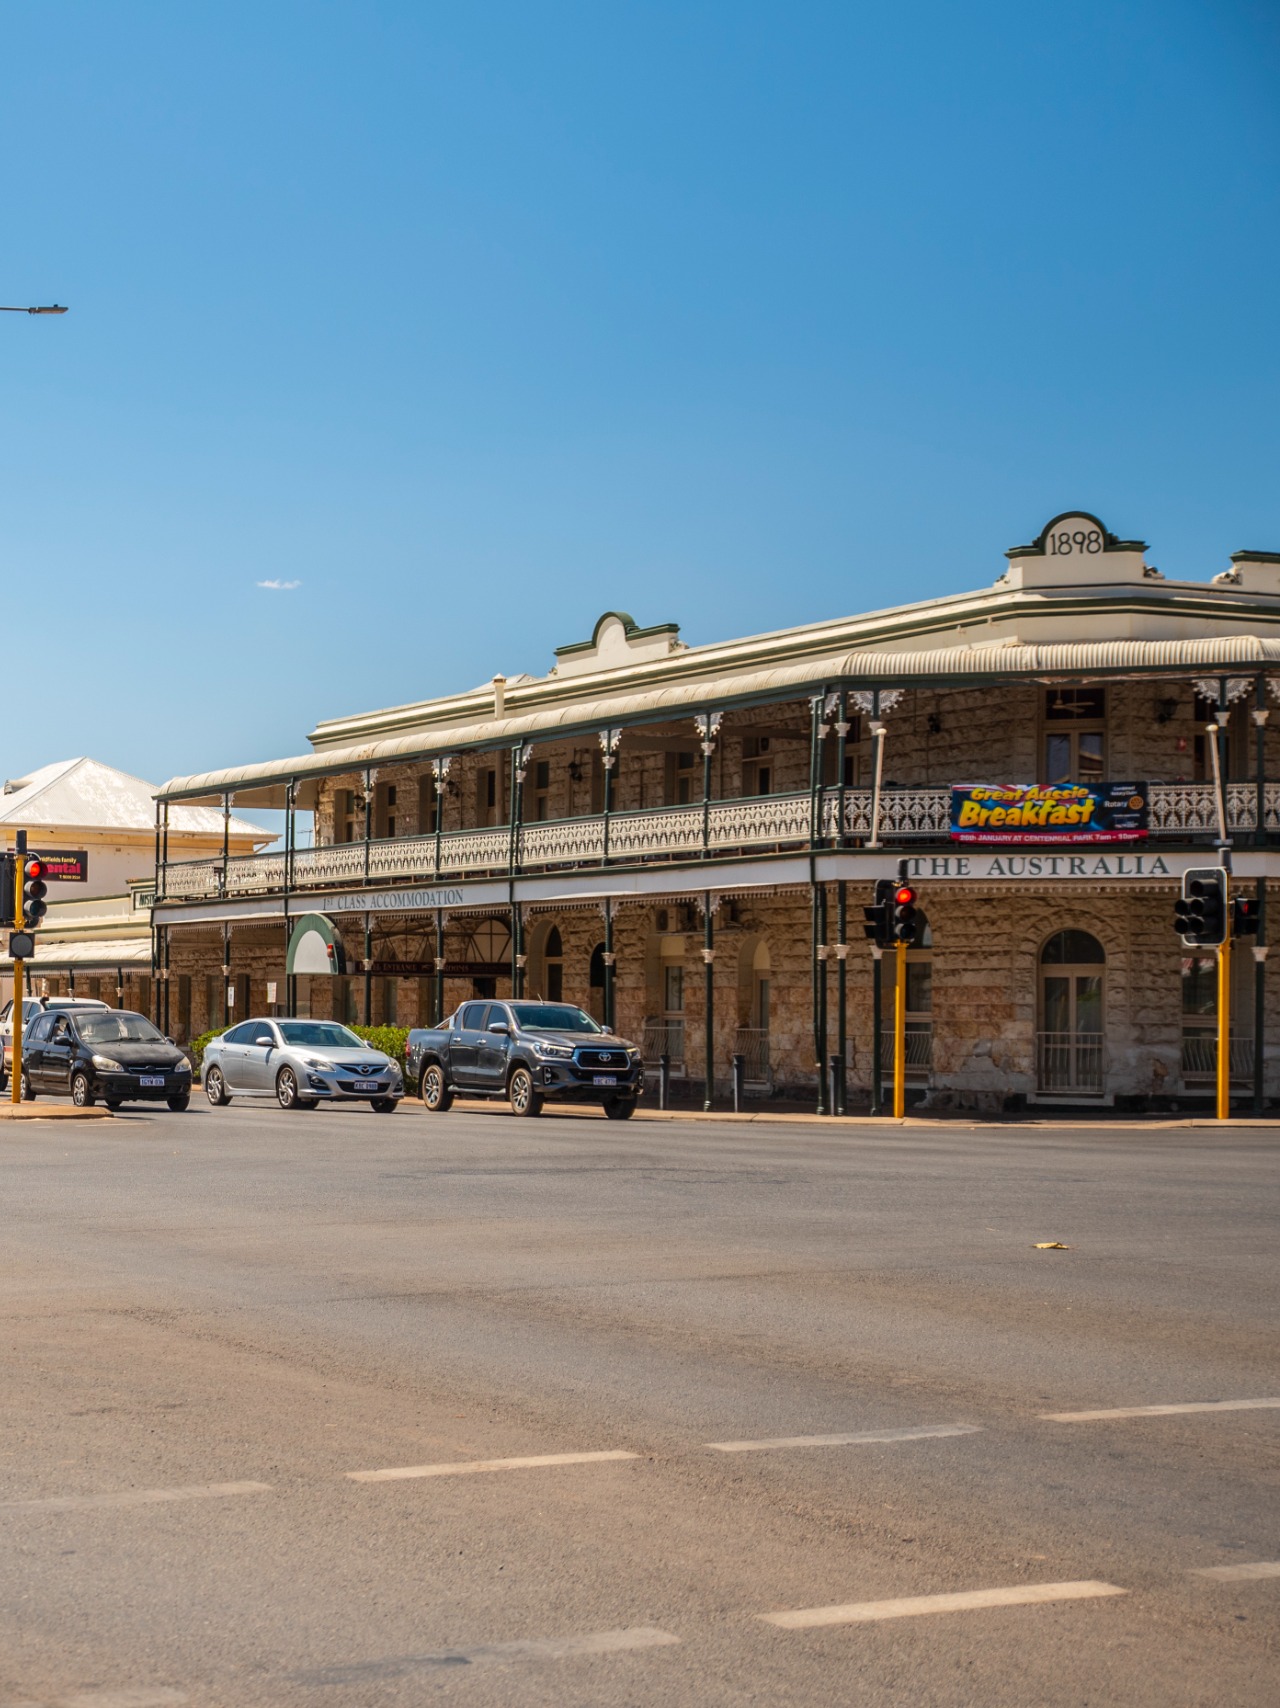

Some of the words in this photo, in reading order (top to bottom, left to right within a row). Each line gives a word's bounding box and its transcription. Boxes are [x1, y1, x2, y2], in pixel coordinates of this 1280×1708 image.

[1050, 530, 1101, 555] 1898
[971, 788, 1022, 801] Great
[1025, 786, 1089, 801] Aussie
[1104, 800, 1128, 808] Rotary
[958, 798, 1095, 827] Breakfast
[977, 834, 1011, 842] JANUARY
[61, 856, 77, 864] family
[908, 857, 971, 876] THE
[986, 855, 1170, 876] AUSTRALIA
[47, 863, 81, 873] ental
[337, 894, 366, 910] CLASS
[370, 888, 464, 908] ACCOMMODATION
